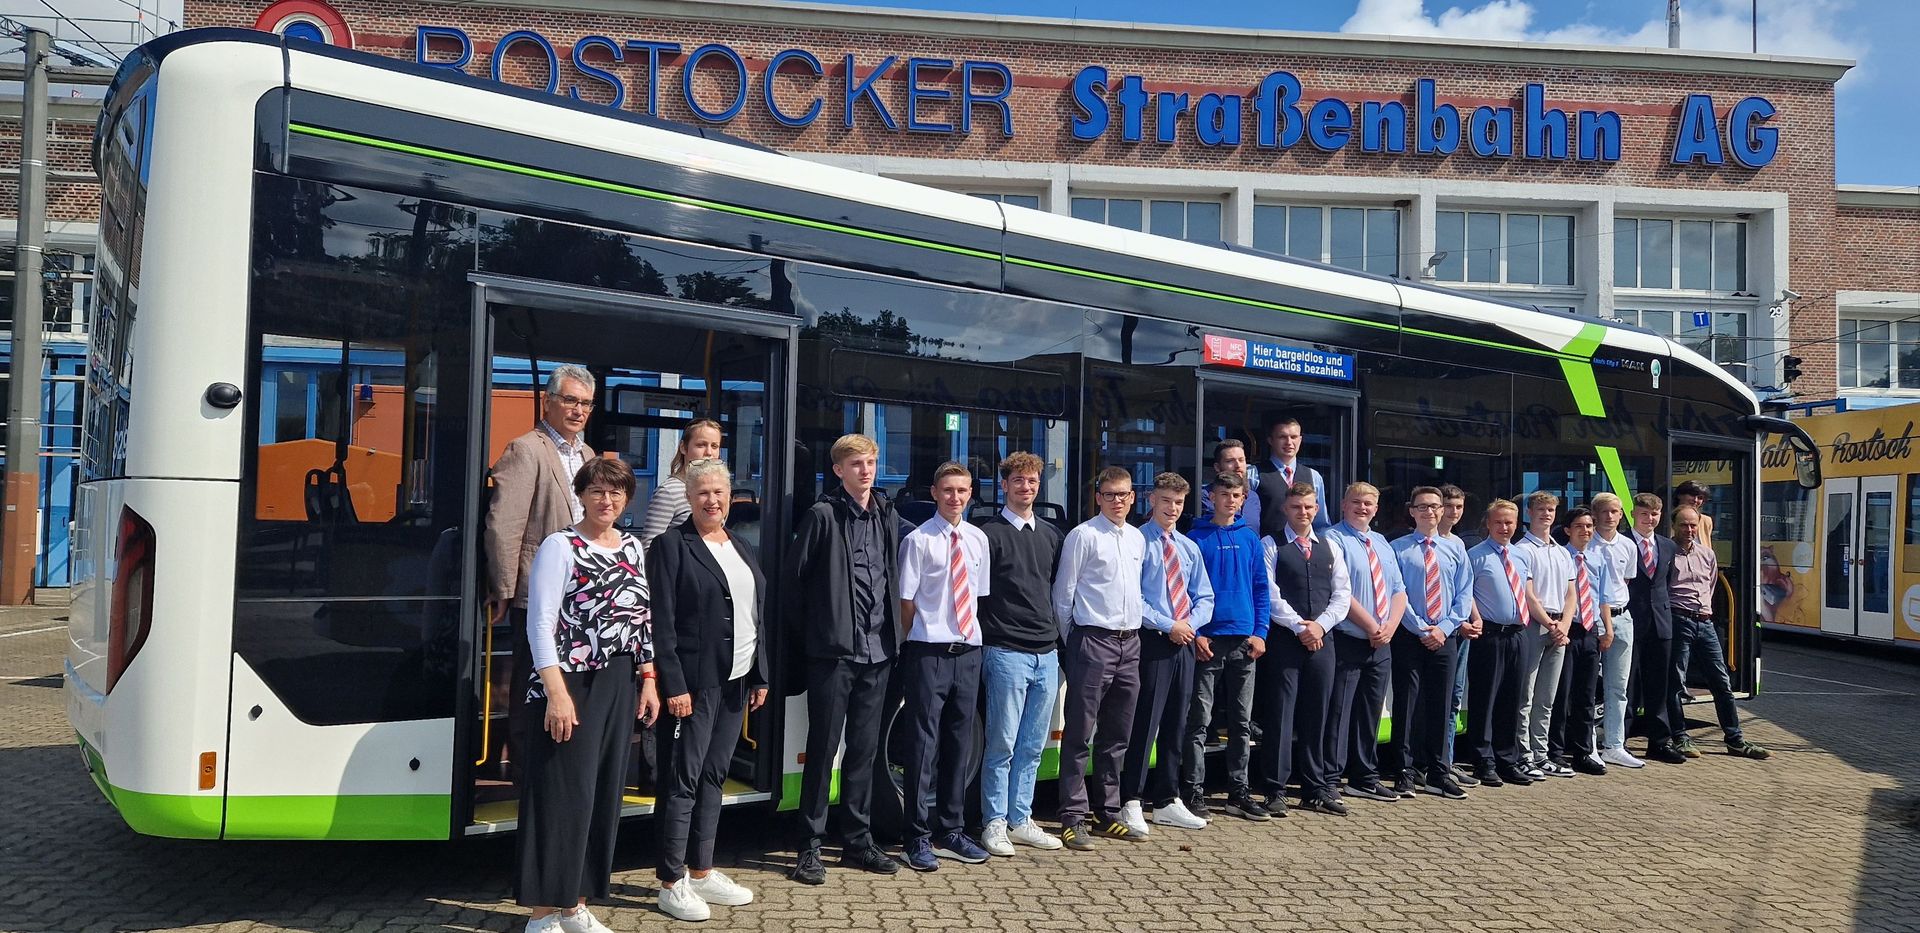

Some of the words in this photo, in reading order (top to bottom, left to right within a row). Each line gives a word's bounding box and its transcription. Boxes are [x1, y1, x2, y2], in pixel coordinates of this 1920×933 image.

[416, 25, 1014, 137] ROSTOCKER
[1071, 65, 1622, 162] Straßenbahn
[1670, 92, 1780, 168] AG
[1769, 306, 1783, 318] 29
[1230, 343, 1242, 351] NFC
[1253, 343, 1272, 356] Hier
[1275, 346, 1324, 364] bargeldlos
[1326, 355, 1343, 367] und
[1253, 357, 1302, 372] kontaktlos
[1304, 361, 1347, 378] bezahlen.
[1831, 421, 1914, 464] Rostock
